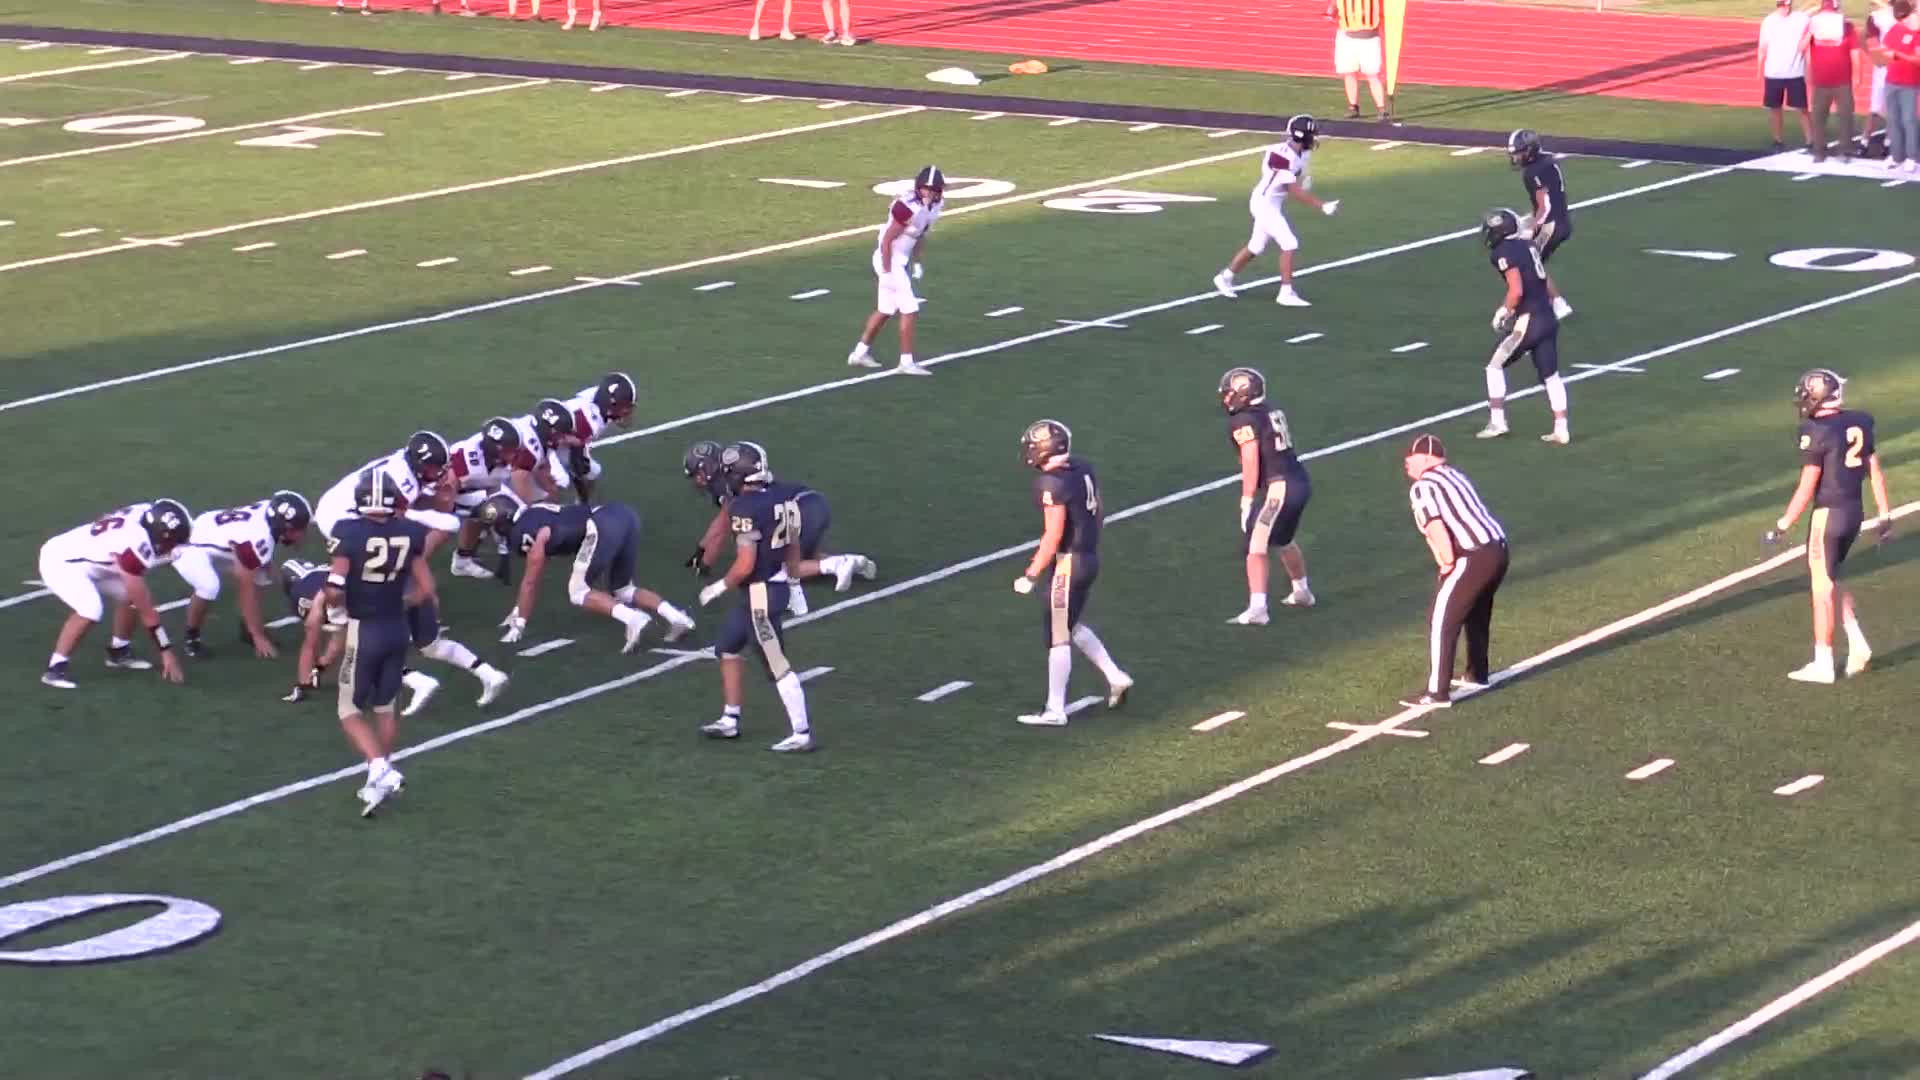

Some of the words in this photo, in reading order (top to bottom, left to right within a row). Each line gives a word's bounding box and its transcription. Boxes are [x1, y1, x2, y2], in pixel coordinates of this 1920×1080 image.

[1844, 426, 1864, 468] 2
[1084, 474, 1098, 515] 4
[361, 536, 410, 582] 27
